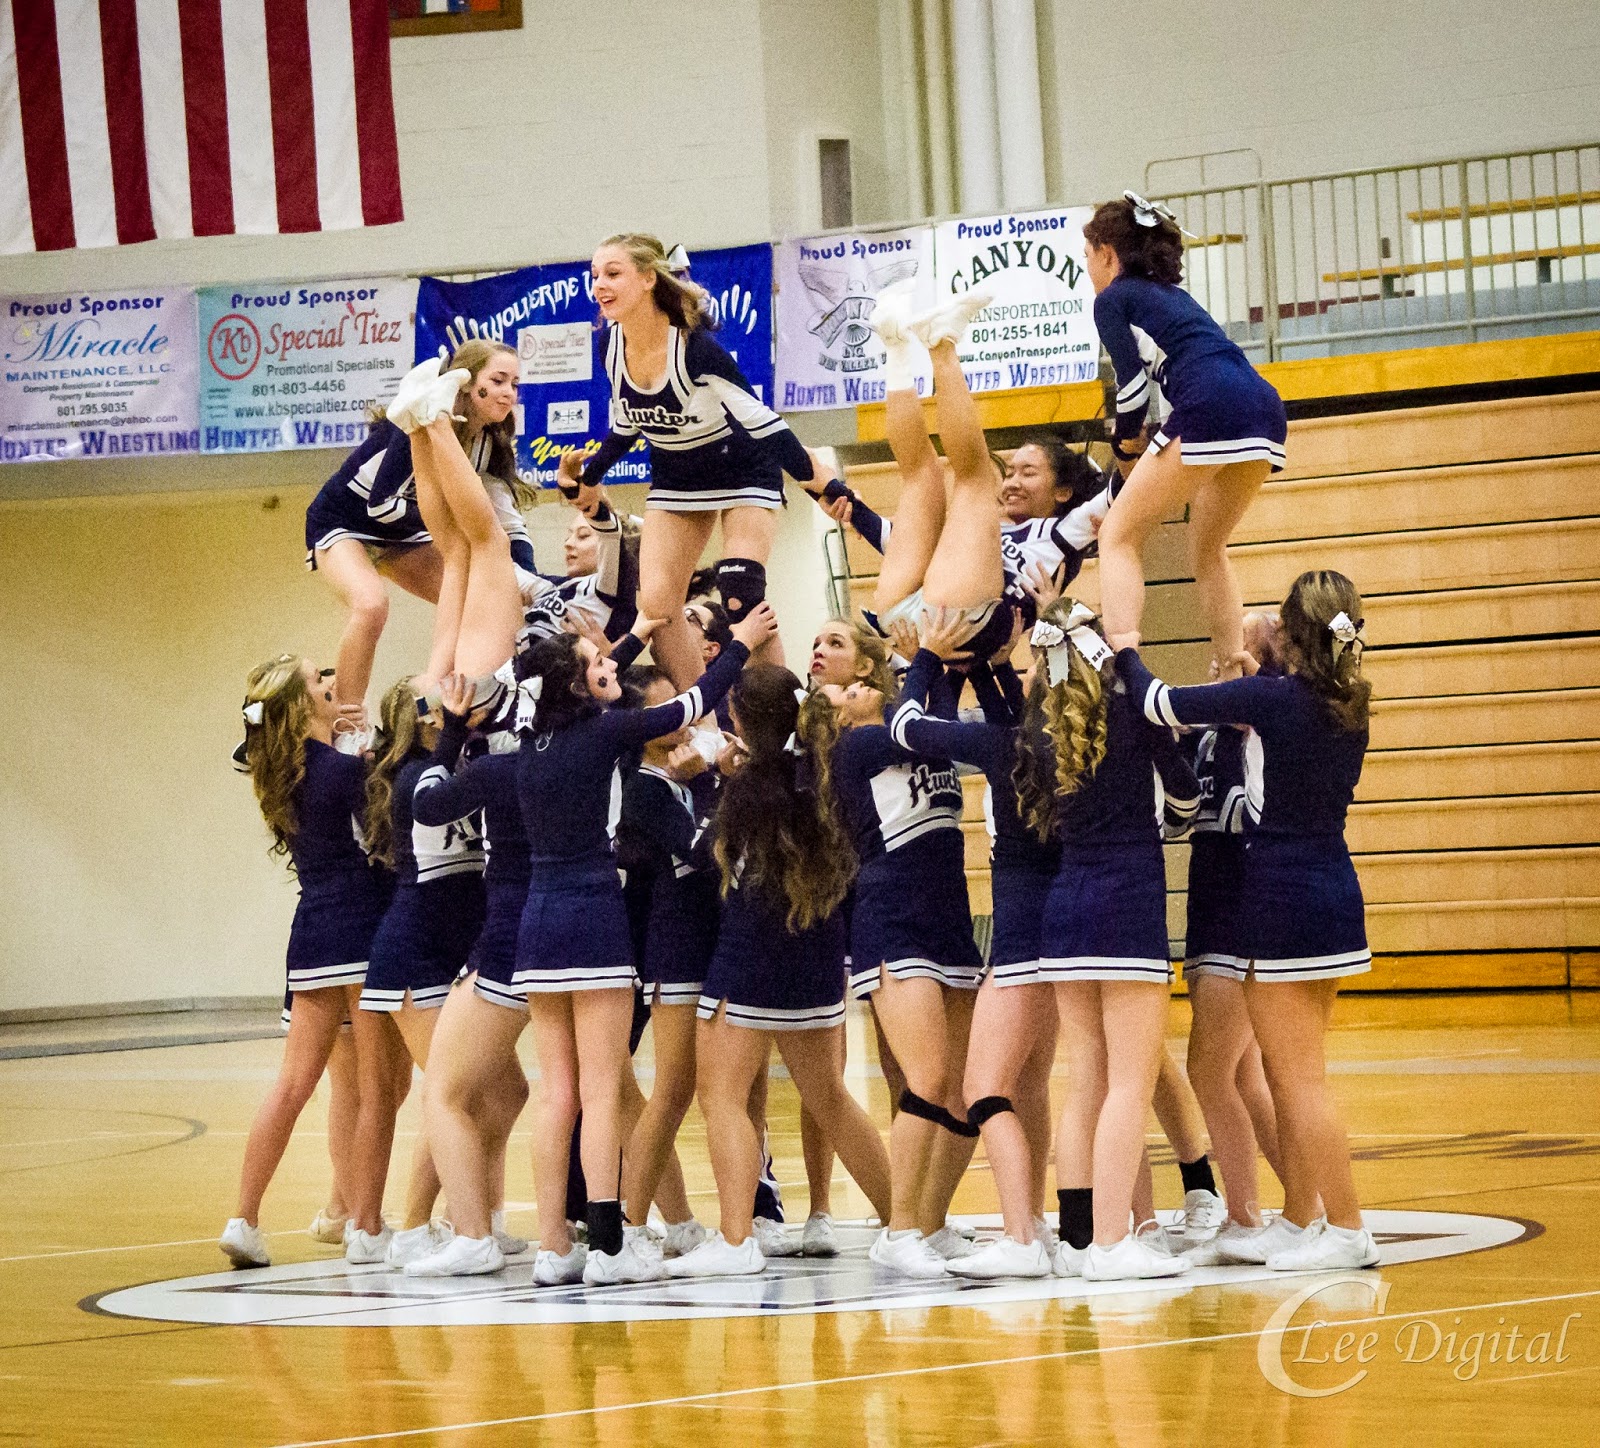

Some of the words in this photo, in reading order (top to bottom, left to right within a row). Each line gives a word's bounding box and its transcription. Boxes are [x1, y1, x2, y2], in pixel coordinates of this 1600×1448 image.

[958, 219, 1003, 239] Proud
[1009, 216, 1067, 238] Sponsor
[800, 242, 846, 260] Proud
[852, 239, 911, 259] Sponsor
[951, 240, 1084, 294] CANYON
[10, 298, 72, 317] Proud
[80, 296, 164, 316] Sponsor
[231, 291, 291, 309] Proud
[298, 288, 378, 308] Sponsor
[969, 299, 1083, 323] ANSPORTATION
[5, 318, 169, 363] Miracle
[264, 315, 350, 361] Special
[354, 310, 402, 346] Tiez
[972, 321, 1068, 343] 801-255-1841
[217, 327, 252, 364] Kb
[959, 342, 1091, 363] ww.CanyonTransport.com
[266, 361, 333, 376] Promotional
[336, 357, 395, 371] Specialists
[964, 371, 1001, 391] NTER
[1009, 361, 1096, 387] WRESTLING
[252, 380, 346, 397] 801-803-4456
[784, 381, 837, 406] HUNTER
[57, 402, 128, 417] 801.295.9035
[0, 437, 68, 460] UNTER
[80, 428, 200, 455] WRESTLING
[295, 420, 369, 444] WREST
[530, 437, 576, 465] You
